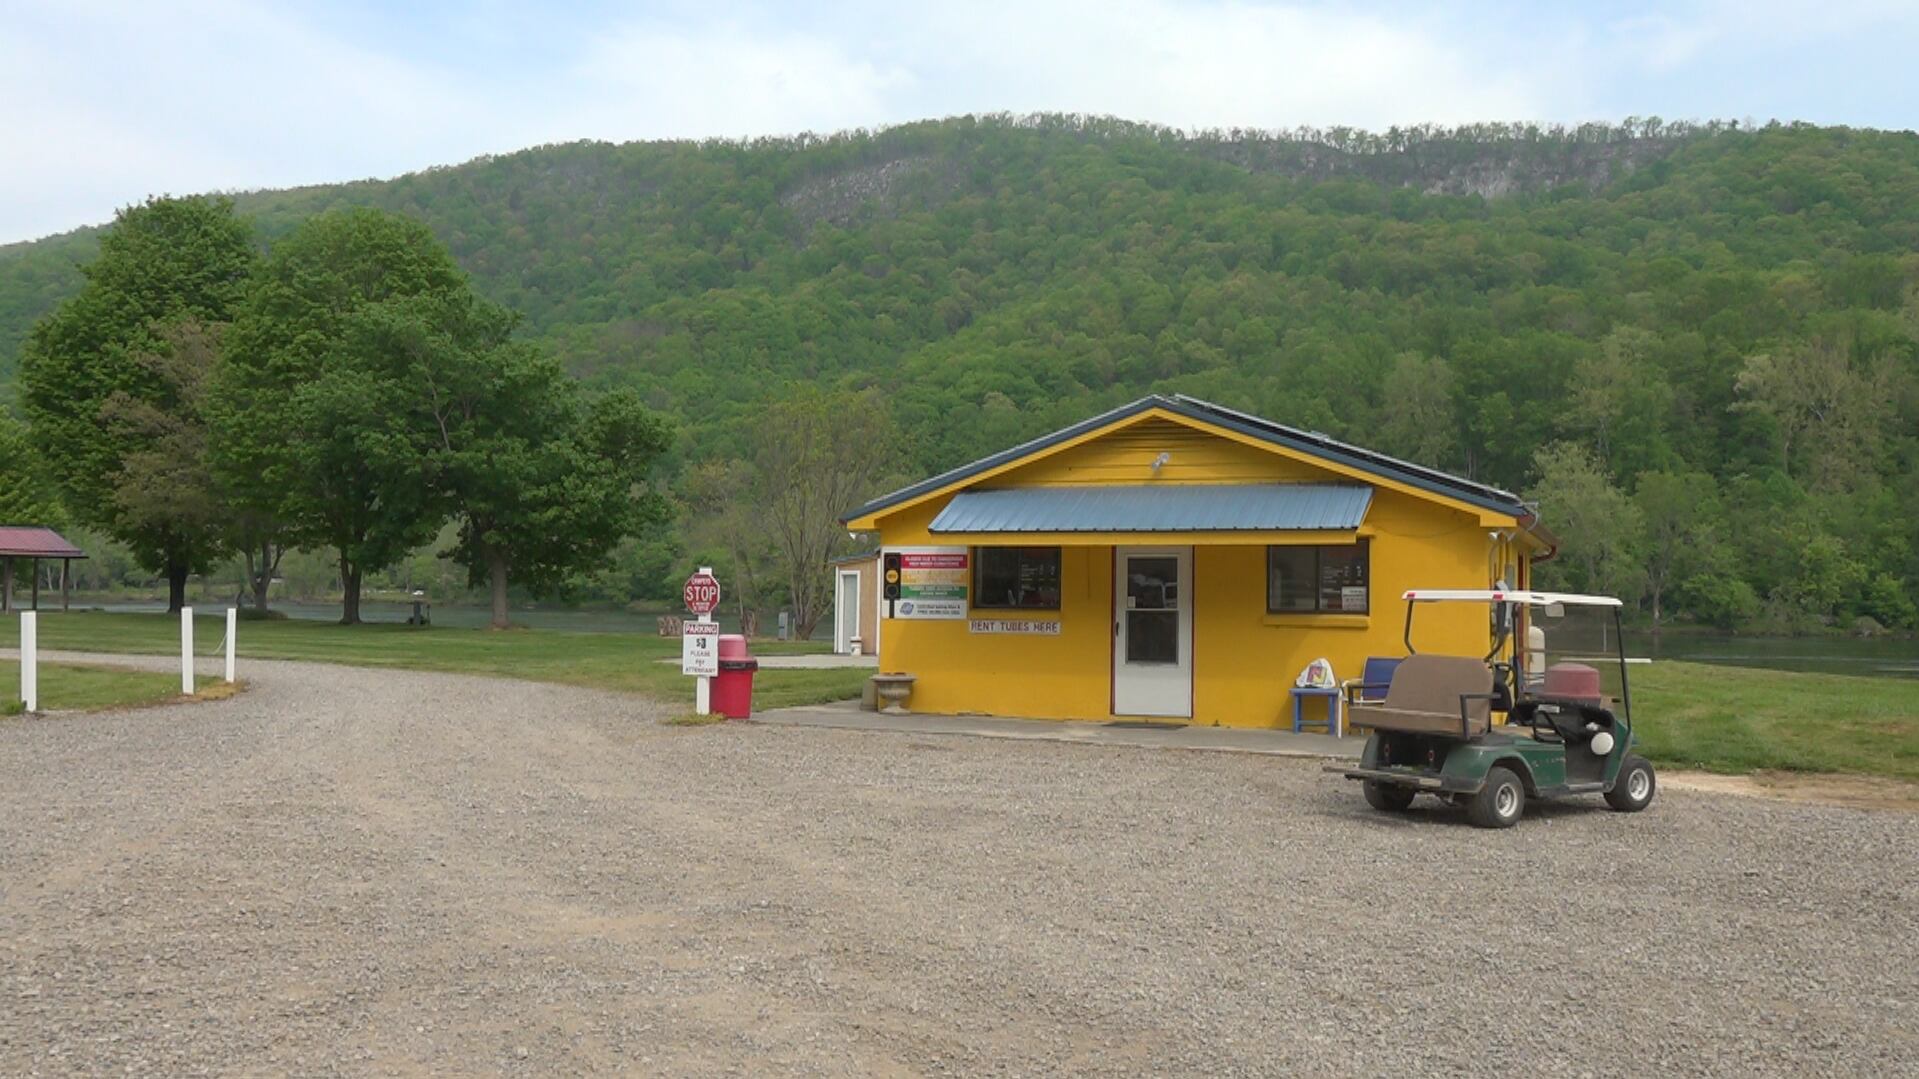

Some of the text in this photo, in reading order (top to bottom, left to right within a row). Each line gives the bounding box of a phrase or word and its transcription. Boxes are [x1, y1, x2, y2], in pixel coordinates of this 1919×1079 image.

[686, 586, 717, 601] STOP
[685, 624, 717, 634] PARKING
[971, 621, 1058, 633] RENT TUBES HERE
